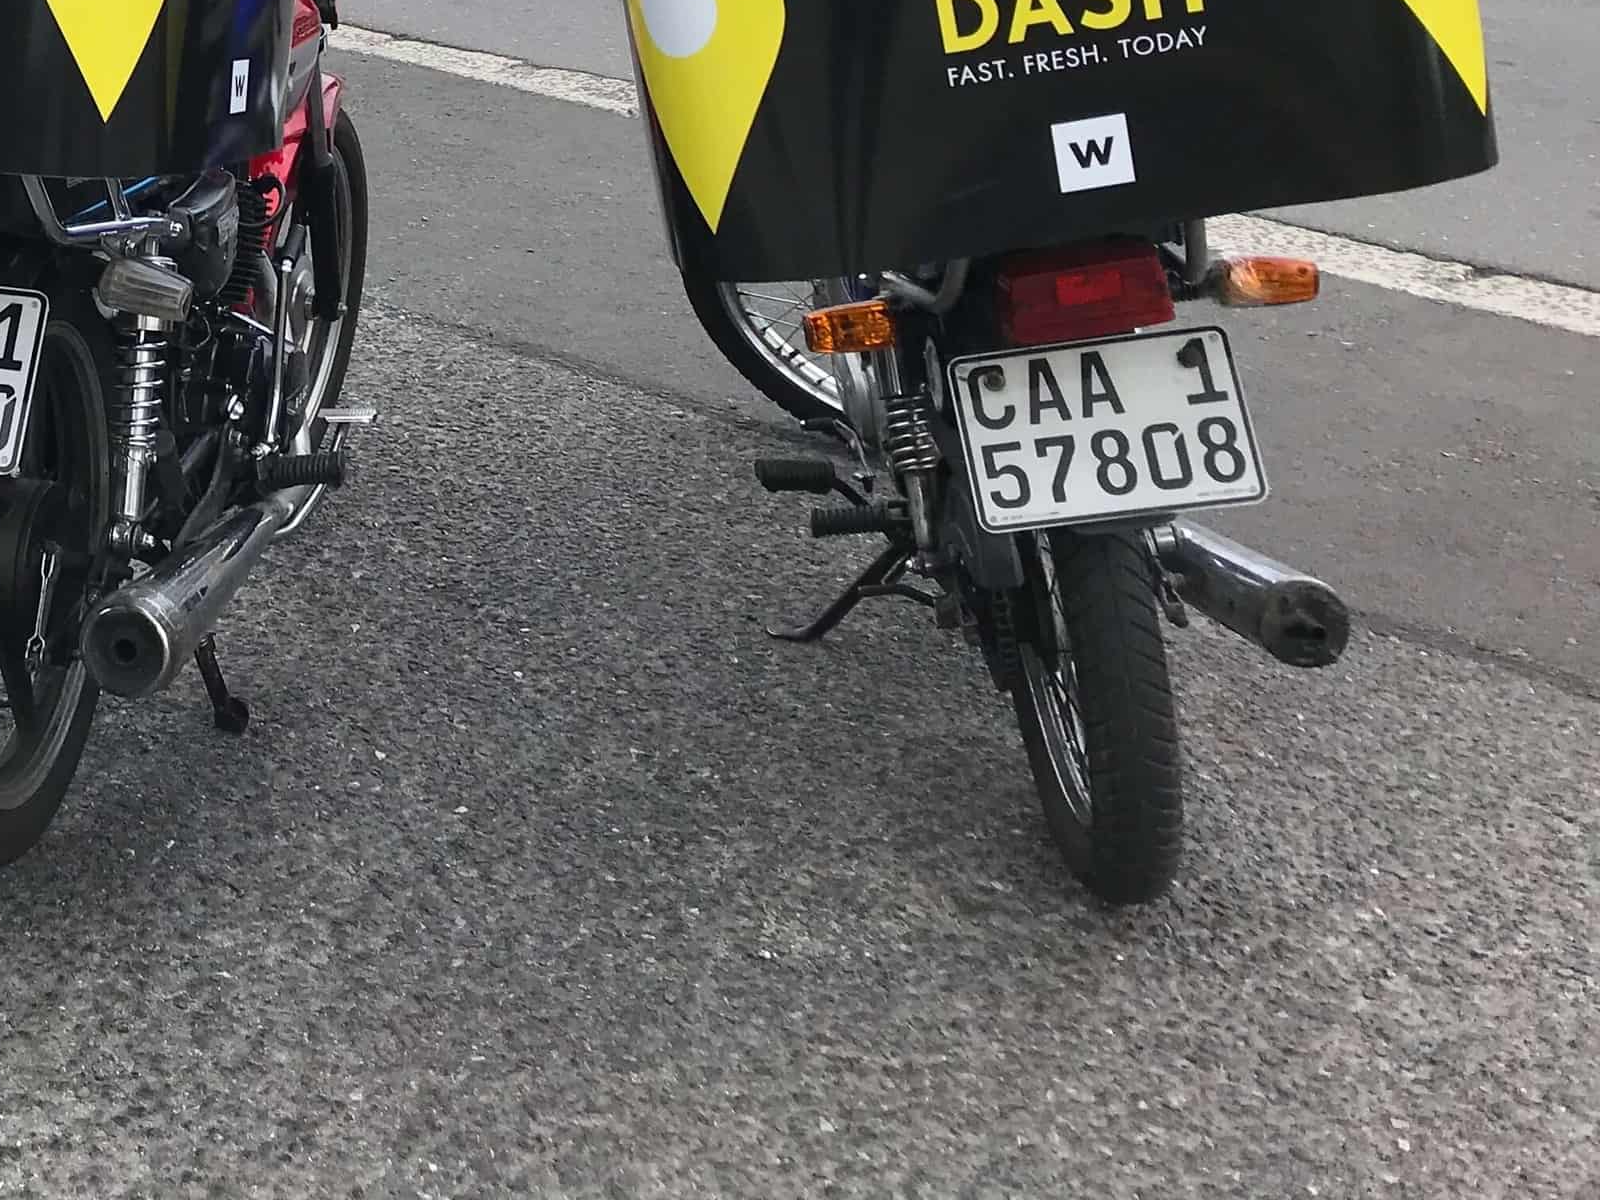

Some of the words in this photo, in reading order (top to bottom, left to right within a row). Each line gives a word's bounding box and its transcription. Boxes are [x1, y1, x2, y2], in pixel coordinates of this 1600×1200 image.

[946, 59, 1015, 87] FAST.
[1023, 44, 1108, 76] FRESH.
[1117, 25, 1208, 59] TODAY
[1068, 136, 1114, 169] W
[967, 350, 1126, 430] CAA
[1176, 337, 1229, 405] 1
[981, 416, 1247, 509] 57808
